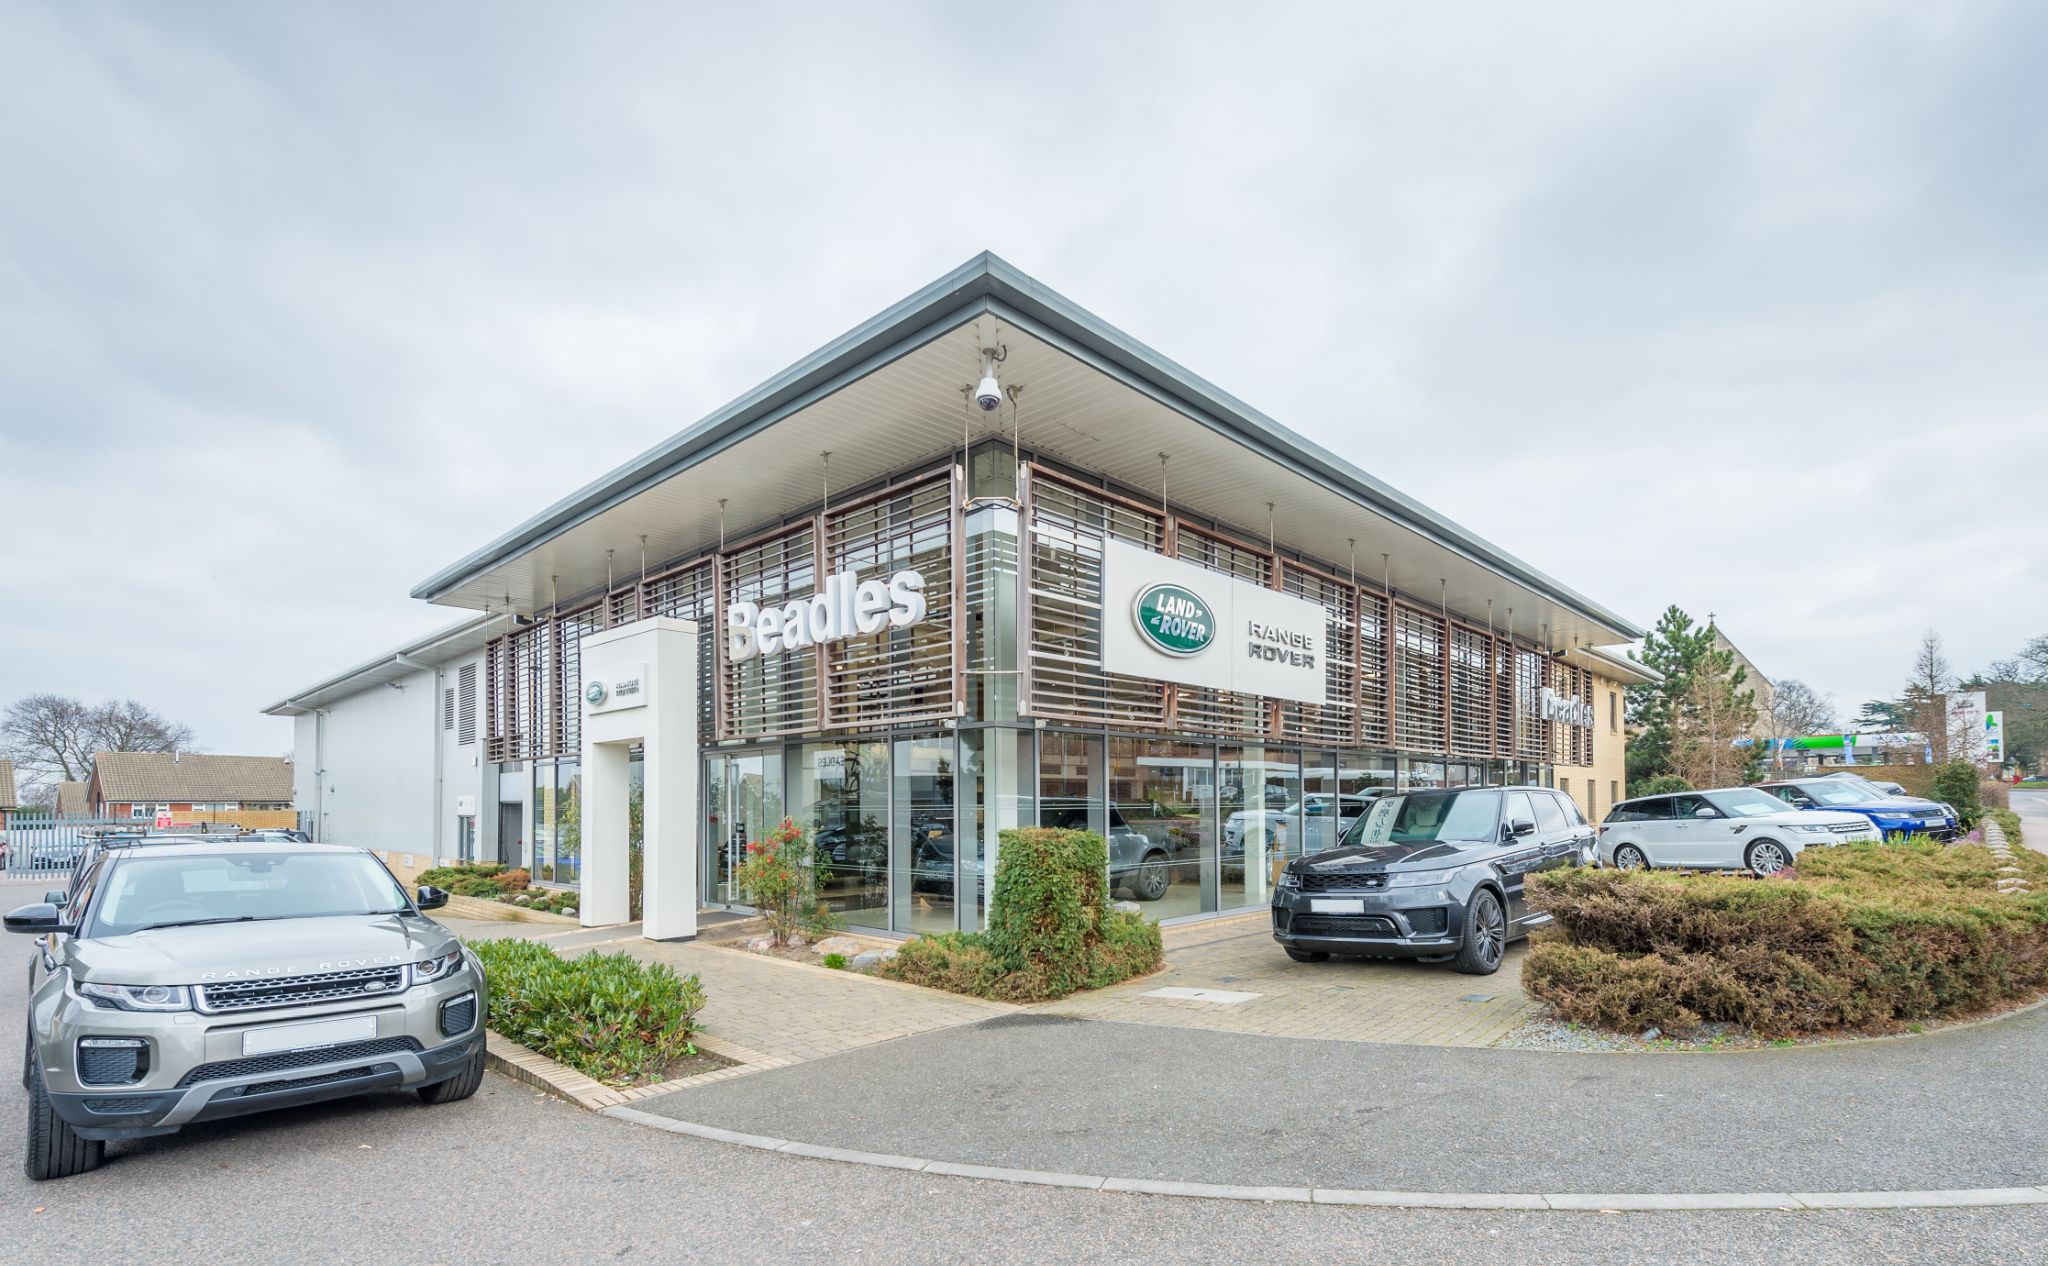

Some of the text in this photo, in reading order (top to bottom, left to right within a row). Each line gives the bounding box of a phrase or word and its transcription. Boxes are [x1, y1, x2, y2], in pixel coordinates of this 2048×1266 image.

[728, 570, 927, 664] Beadles
[1156, 593, 1197, 618] LAND
[1159, 615, 1206, 642] ROVER
[1249, 620, 1314, 651] RANGE
[1249, 642, 1316, 669] ROVER
[202, 954, 402, 980] RANGE ROVER
